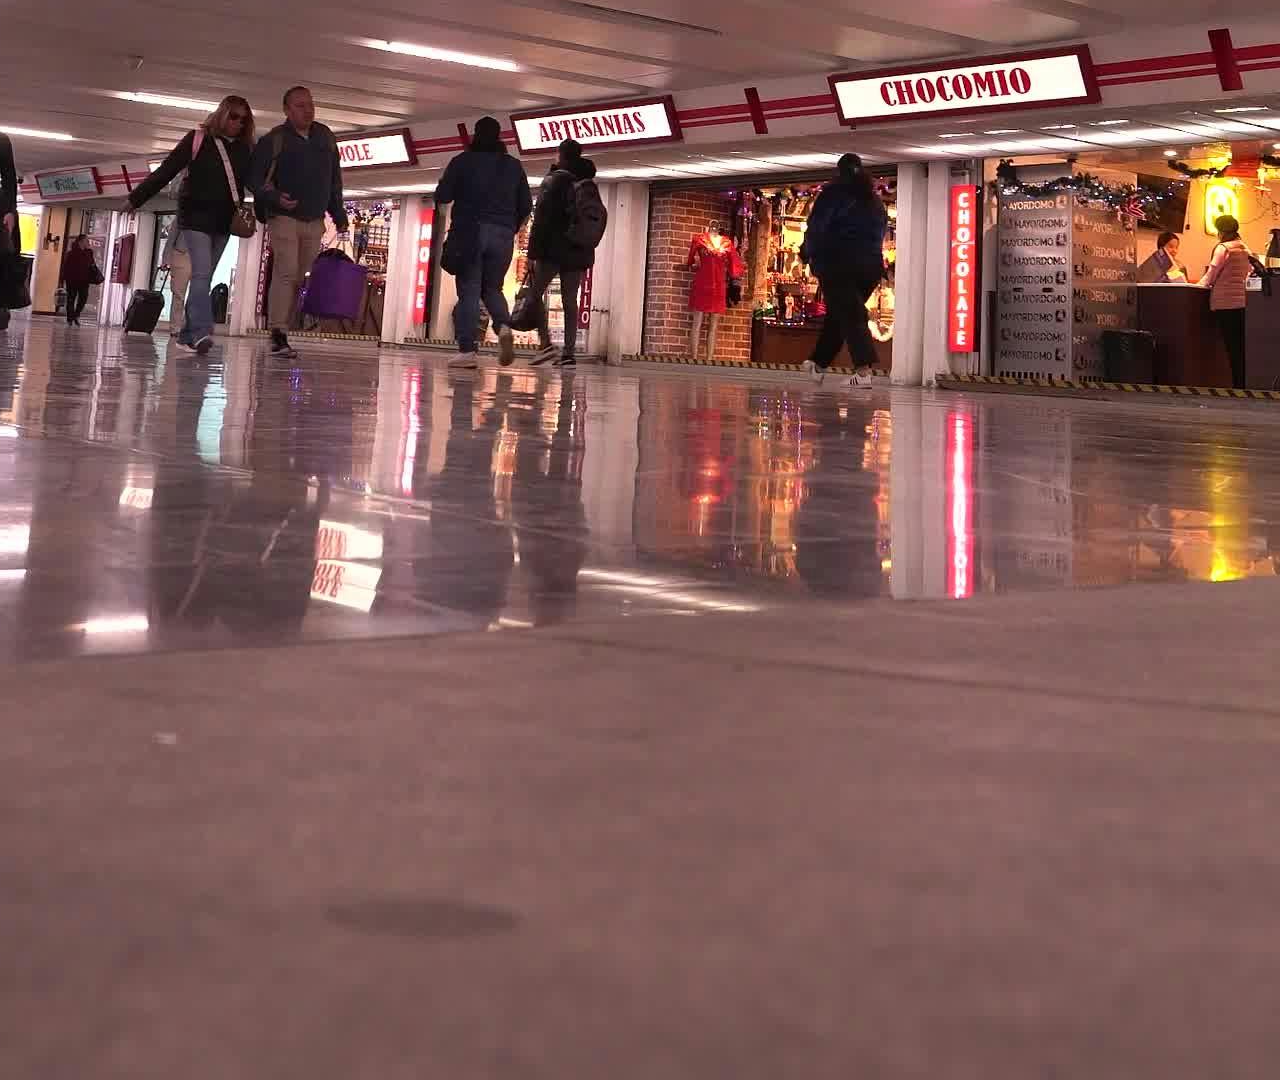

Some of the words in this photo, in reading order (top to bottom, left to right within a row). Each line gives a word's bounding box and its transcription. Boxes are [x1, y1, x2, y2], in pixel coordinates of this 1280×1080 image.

[880, 68, 1032, 107] CHOCOMIO
[538, 111, 646, 142] ARTESANIAS
[1002, 199, 1055, 212] AYORDOMO
[416, 223, 432, 309] MOLE
[956, 192, 970, 345] CHOCOLATE
